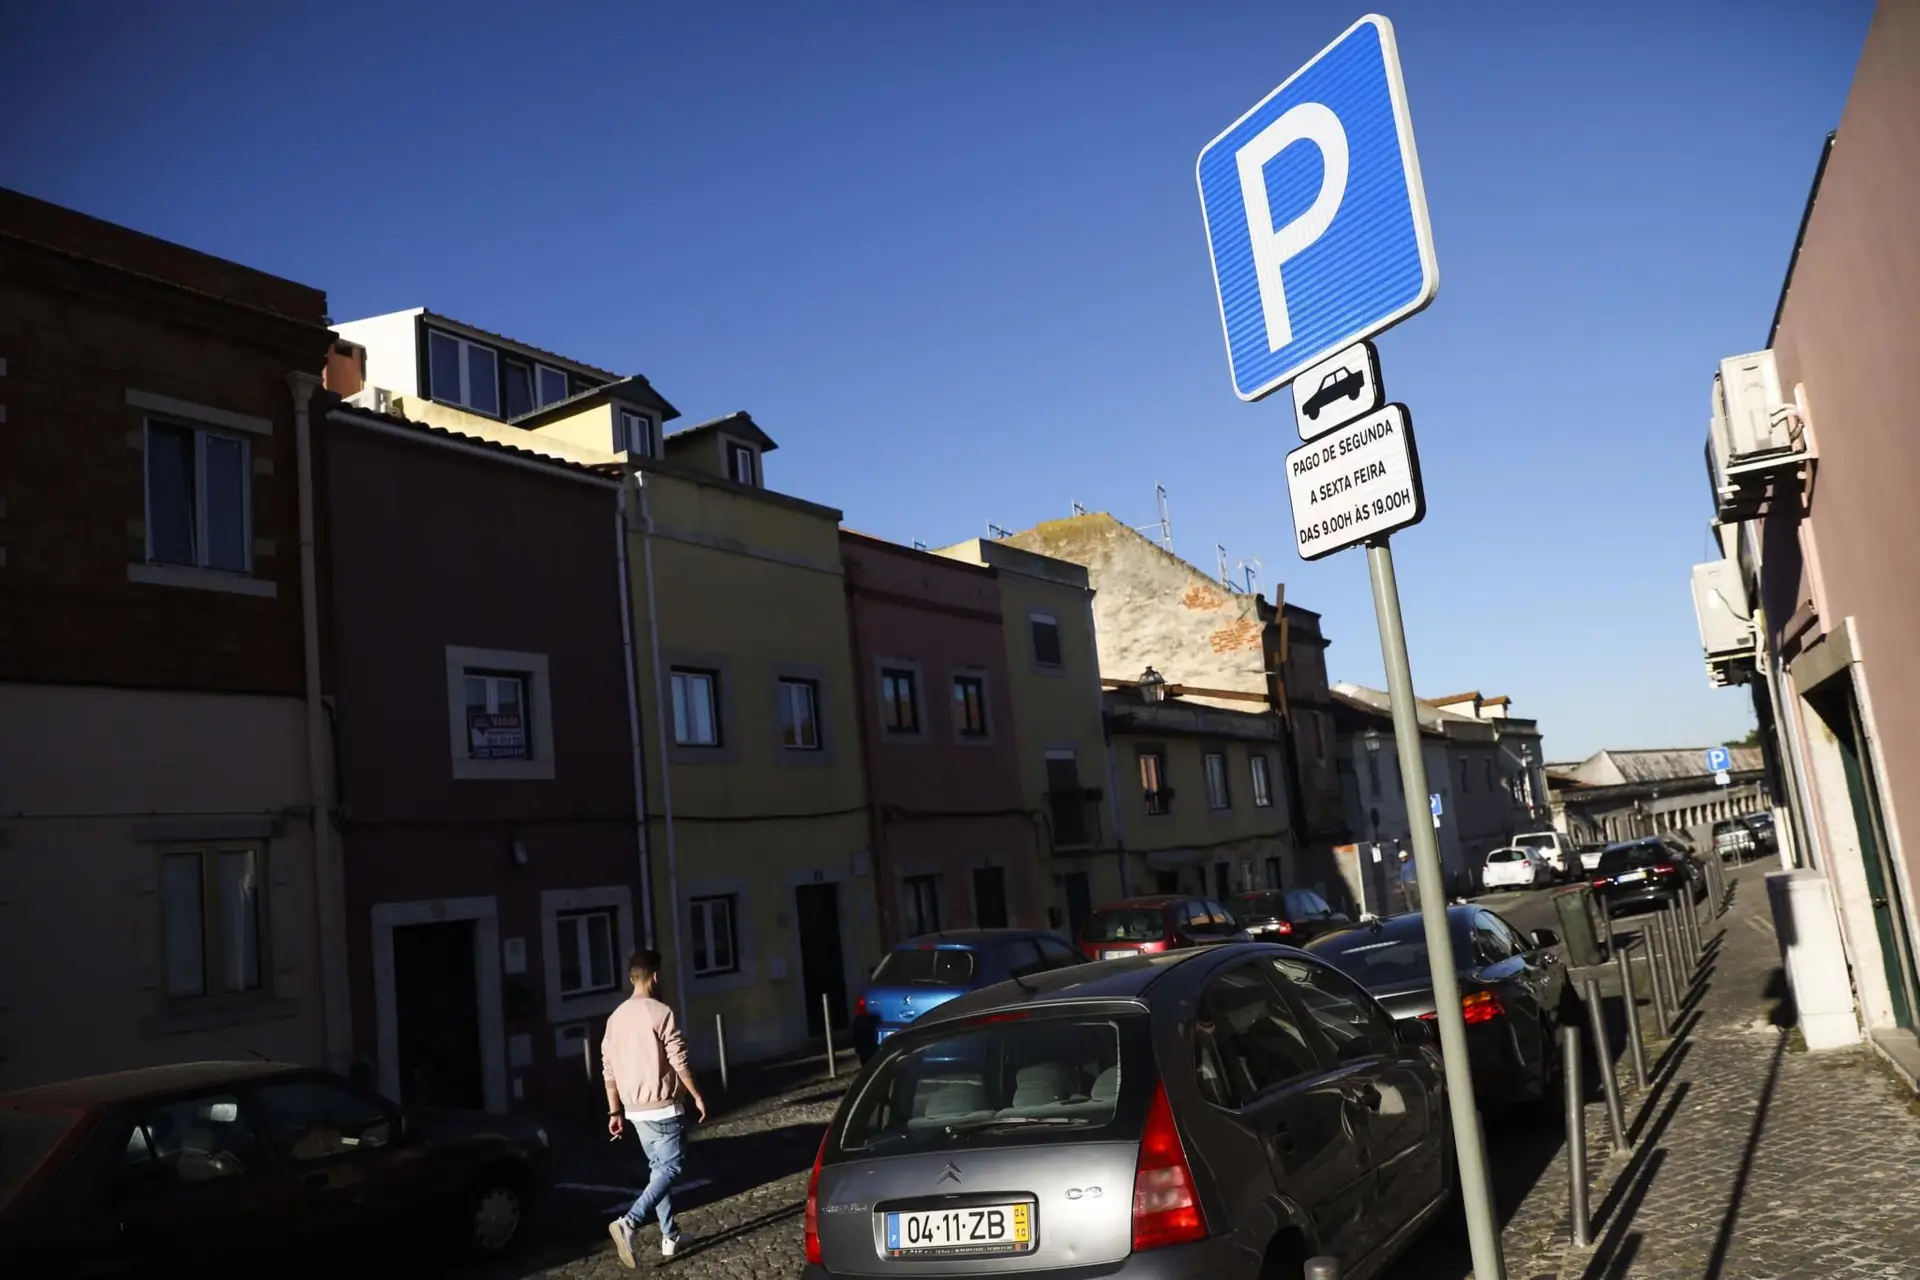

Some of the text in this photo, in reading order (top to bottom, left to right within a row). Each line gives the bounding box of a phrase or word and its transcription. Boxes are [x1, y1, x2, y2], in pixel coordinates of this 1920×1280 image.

[1235, 101, 1349, 353] P
[1293, 420, 1393, 477] PAGO DE SEGUNDA
[1310, 460, 1386, 505] A SEXTA FEIRA
[1300, 488, 1410, 545] DAS 9.00H ÀS 19.00H
[1710, 751, 1725, 770] P
[1064, 1186, 1103, 1201] C3
[1014, 1208, 1025, 1218] 04
[1016, 1228, 1027, 1238] 10
